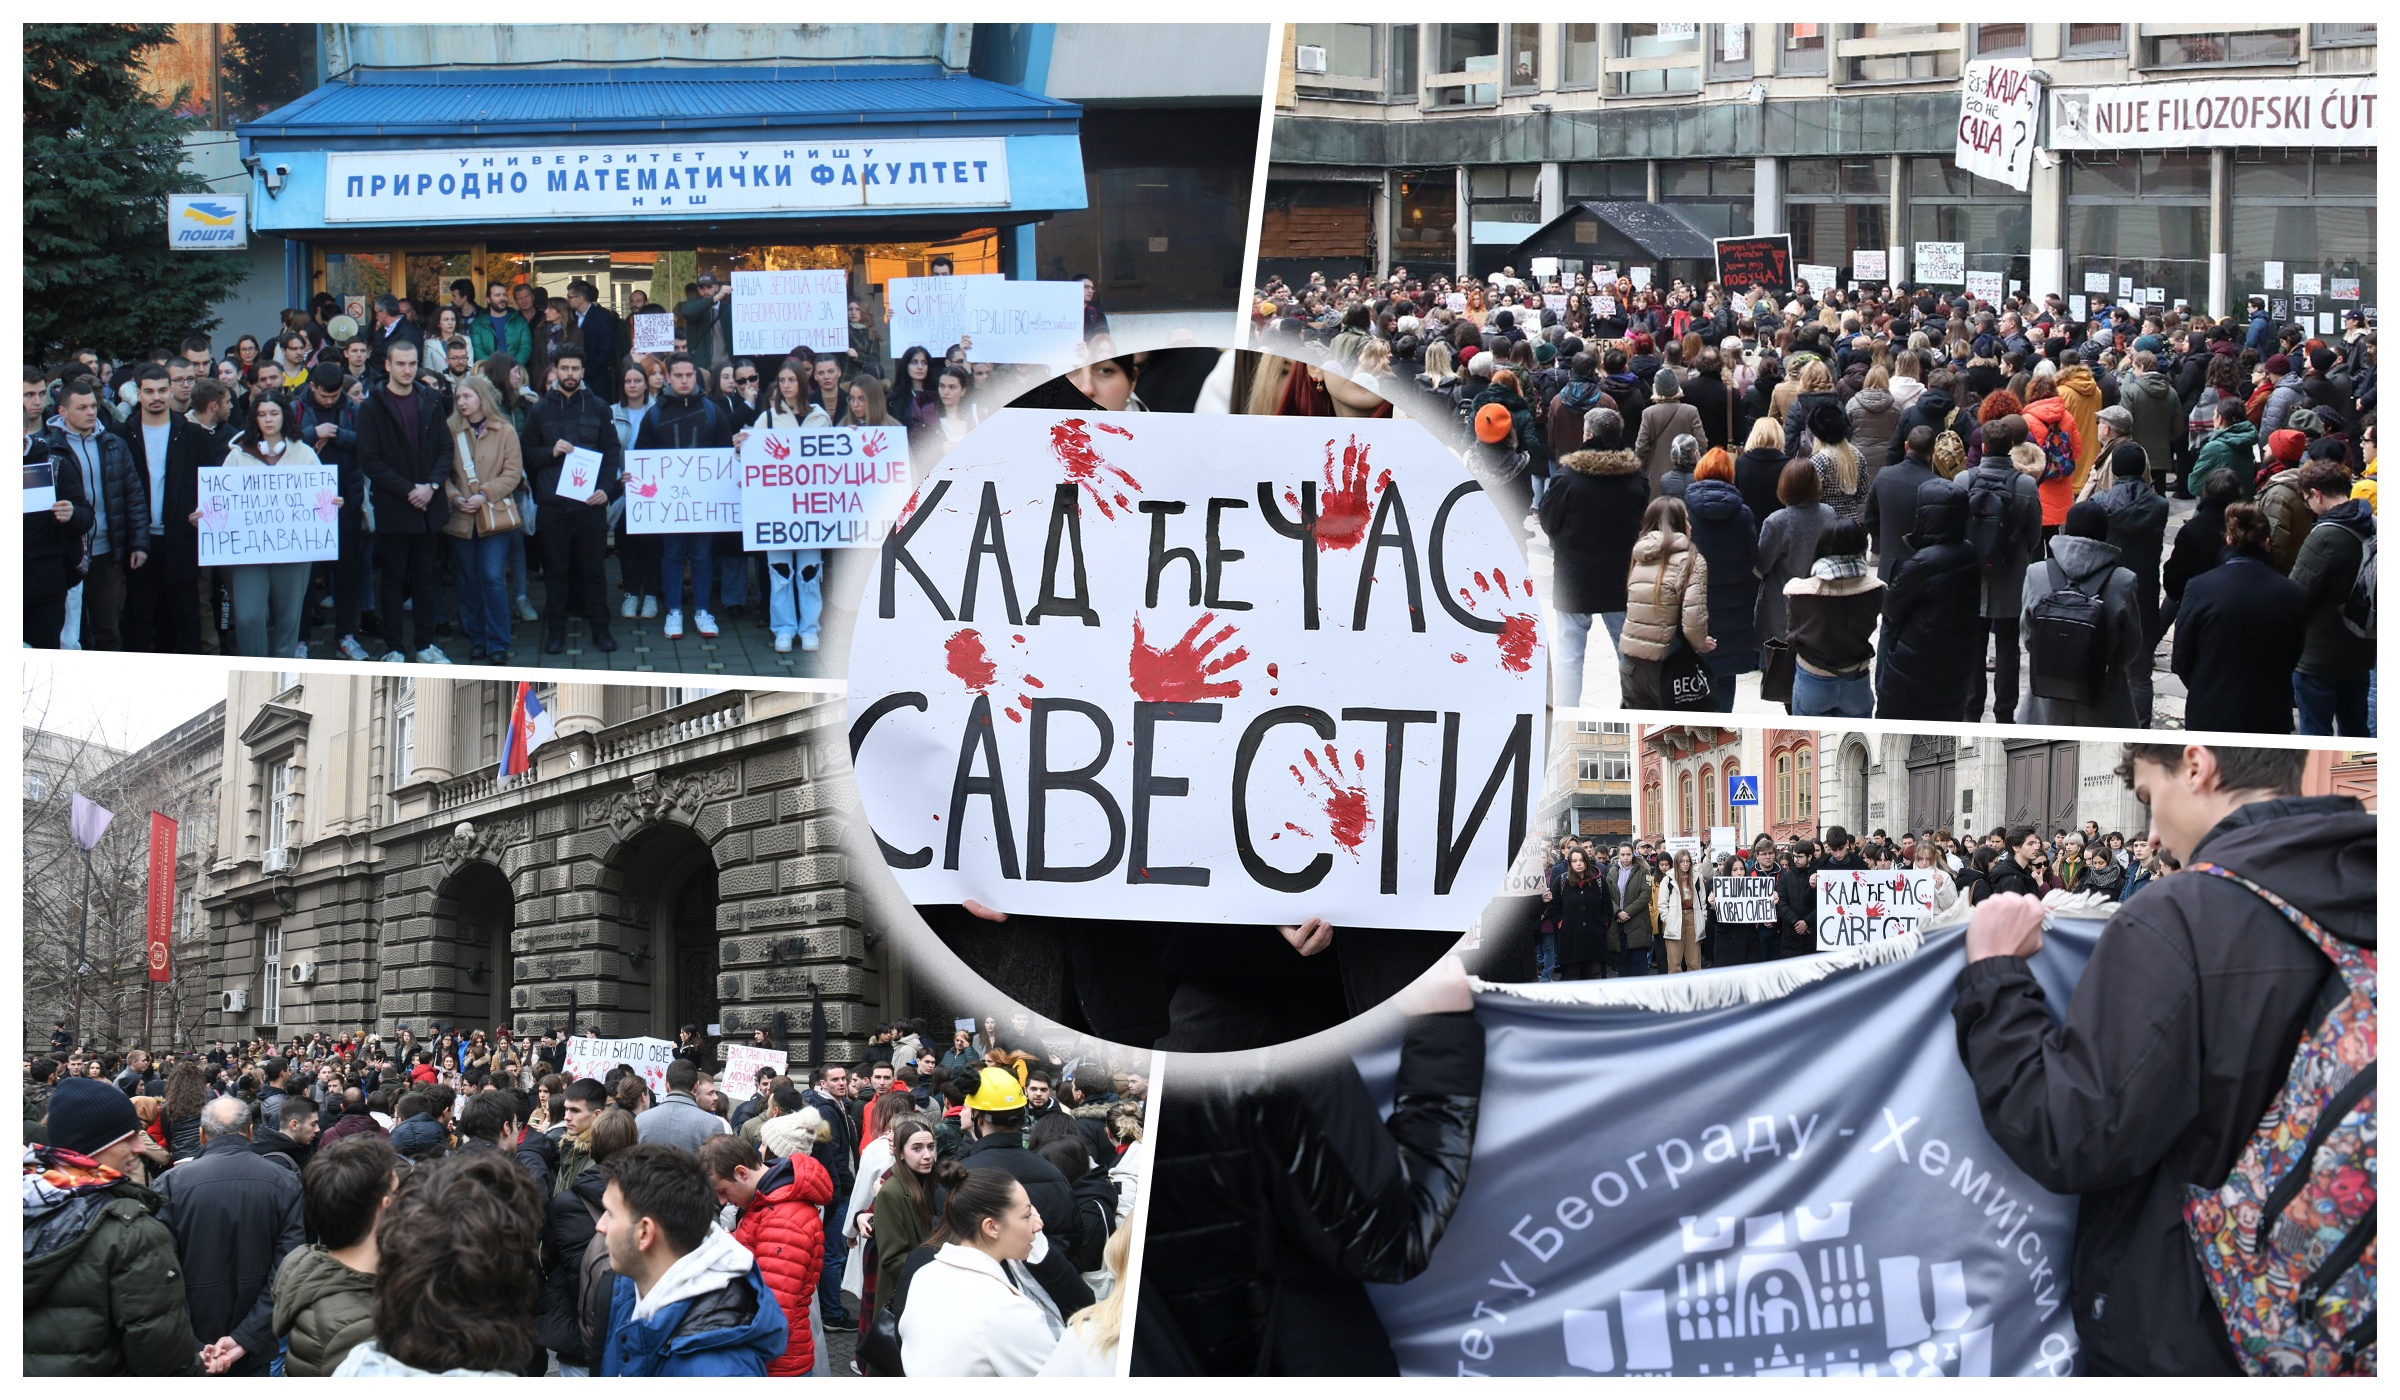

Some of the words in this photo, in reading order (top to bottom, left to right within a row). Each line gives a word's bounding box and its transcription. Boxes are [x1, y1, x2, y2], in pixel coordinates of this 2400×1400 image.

[2096, 100, 2149, 133] NIJE
[2157, 95, 2310, 132] FILOZOFSKI
[458, 151, 706, 168] УНИВЕРЗИТЕТ
[739, 150, 750, 161] У
[783, 148, 874, 160] НИШУ
[347, 170, 528, 200] ПРИРОДНО
[547, 164, 792, 192] МАТЕМАТИЧКИ
[810, 160, 988, 186] ФАКУЛТЕТ
[632, 194, 707, 207] НИШ
[178, 229, 236, 242] ПОШТА
[736, 276, 763, 296] НАША
[770, 275, 811, 295] ЗЕМЉА
[814, 273, 844, 294] НИЈЕ
[735, 301, 814, 323] ЛАБОРАТОРИЈА
[819, 301, 834, 321] ЗА
[739, 329, 768, 349] ВАШЕ
[799, 433, 853, 457] БЕЗ
[634, 455, 733, 482] ТРУБИ
[745, 461, 907, 489] РЕВОЛУЦИЈЕ
[202, 474, 233, 493] ЧАС
[243, 471, 338, 492] ИНТЕГРИТЕТА
[670, 486, 692, 500] ЗА
[212, 494, 279, 512] БИТНИЈИ
[285, 493, 305, 508] ОД
[632, 500, 741, 524] СТУДЕНТЕ
[792, 491, 864, 515] НЕМА
[245, 508, 284, 526] БИЛО
[292, 507, 321, 522] КОГ
[201, 528, 337, 556] ПРЕДАВАЊА
[878, 479, 1101, 627] КАД
[1257, 479, 1507, 633] ЧАС
[850, 690, 1532, 896] САВЕСТИ
[1714, 877, 1775, 898] РЕШИЋЕМО
[1825, 881, 1861, 906] КАД
[1885, 878, 1928, 906] ЧАС
[1819, 915, 1918, 946] САВЕСТ
[573, 1039, 588, 1056] НЕ
[592, 1041, 608, 1057] БИ
[612, 1041, 644, 1060] БИЛО
[648, 1044, 671, 1063] ОВЕ
[1508, 1113, 1820, 1264] Београду
[1868, 1106, 2061, 1323] Хемијски
